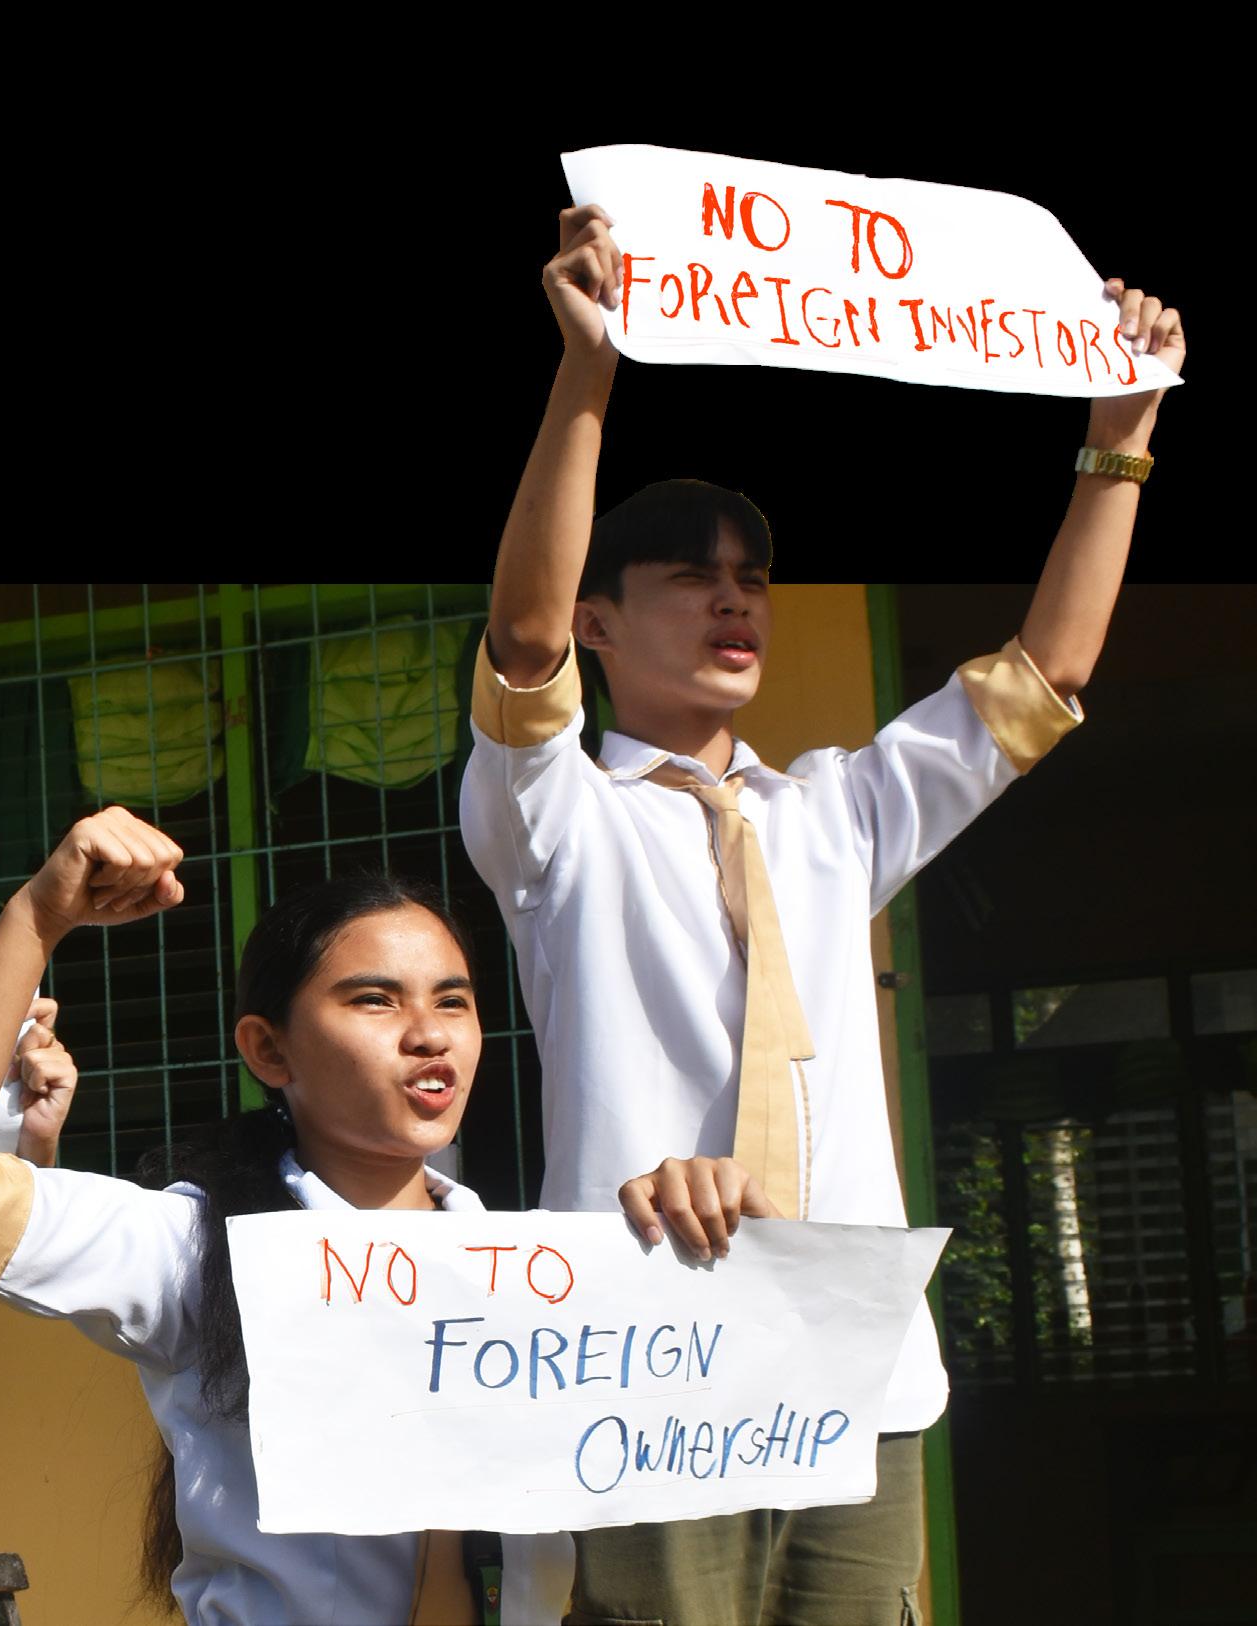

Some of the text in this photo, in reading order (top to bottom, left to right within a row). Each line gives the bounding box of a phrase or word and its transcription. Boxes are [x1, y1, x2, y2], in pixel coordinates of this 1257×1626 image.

[700, 181, 914, 280] NO TO
[319, 1237, 575, 1306] NO TO
[423, 1315, 724, 1400] FOREIGN
